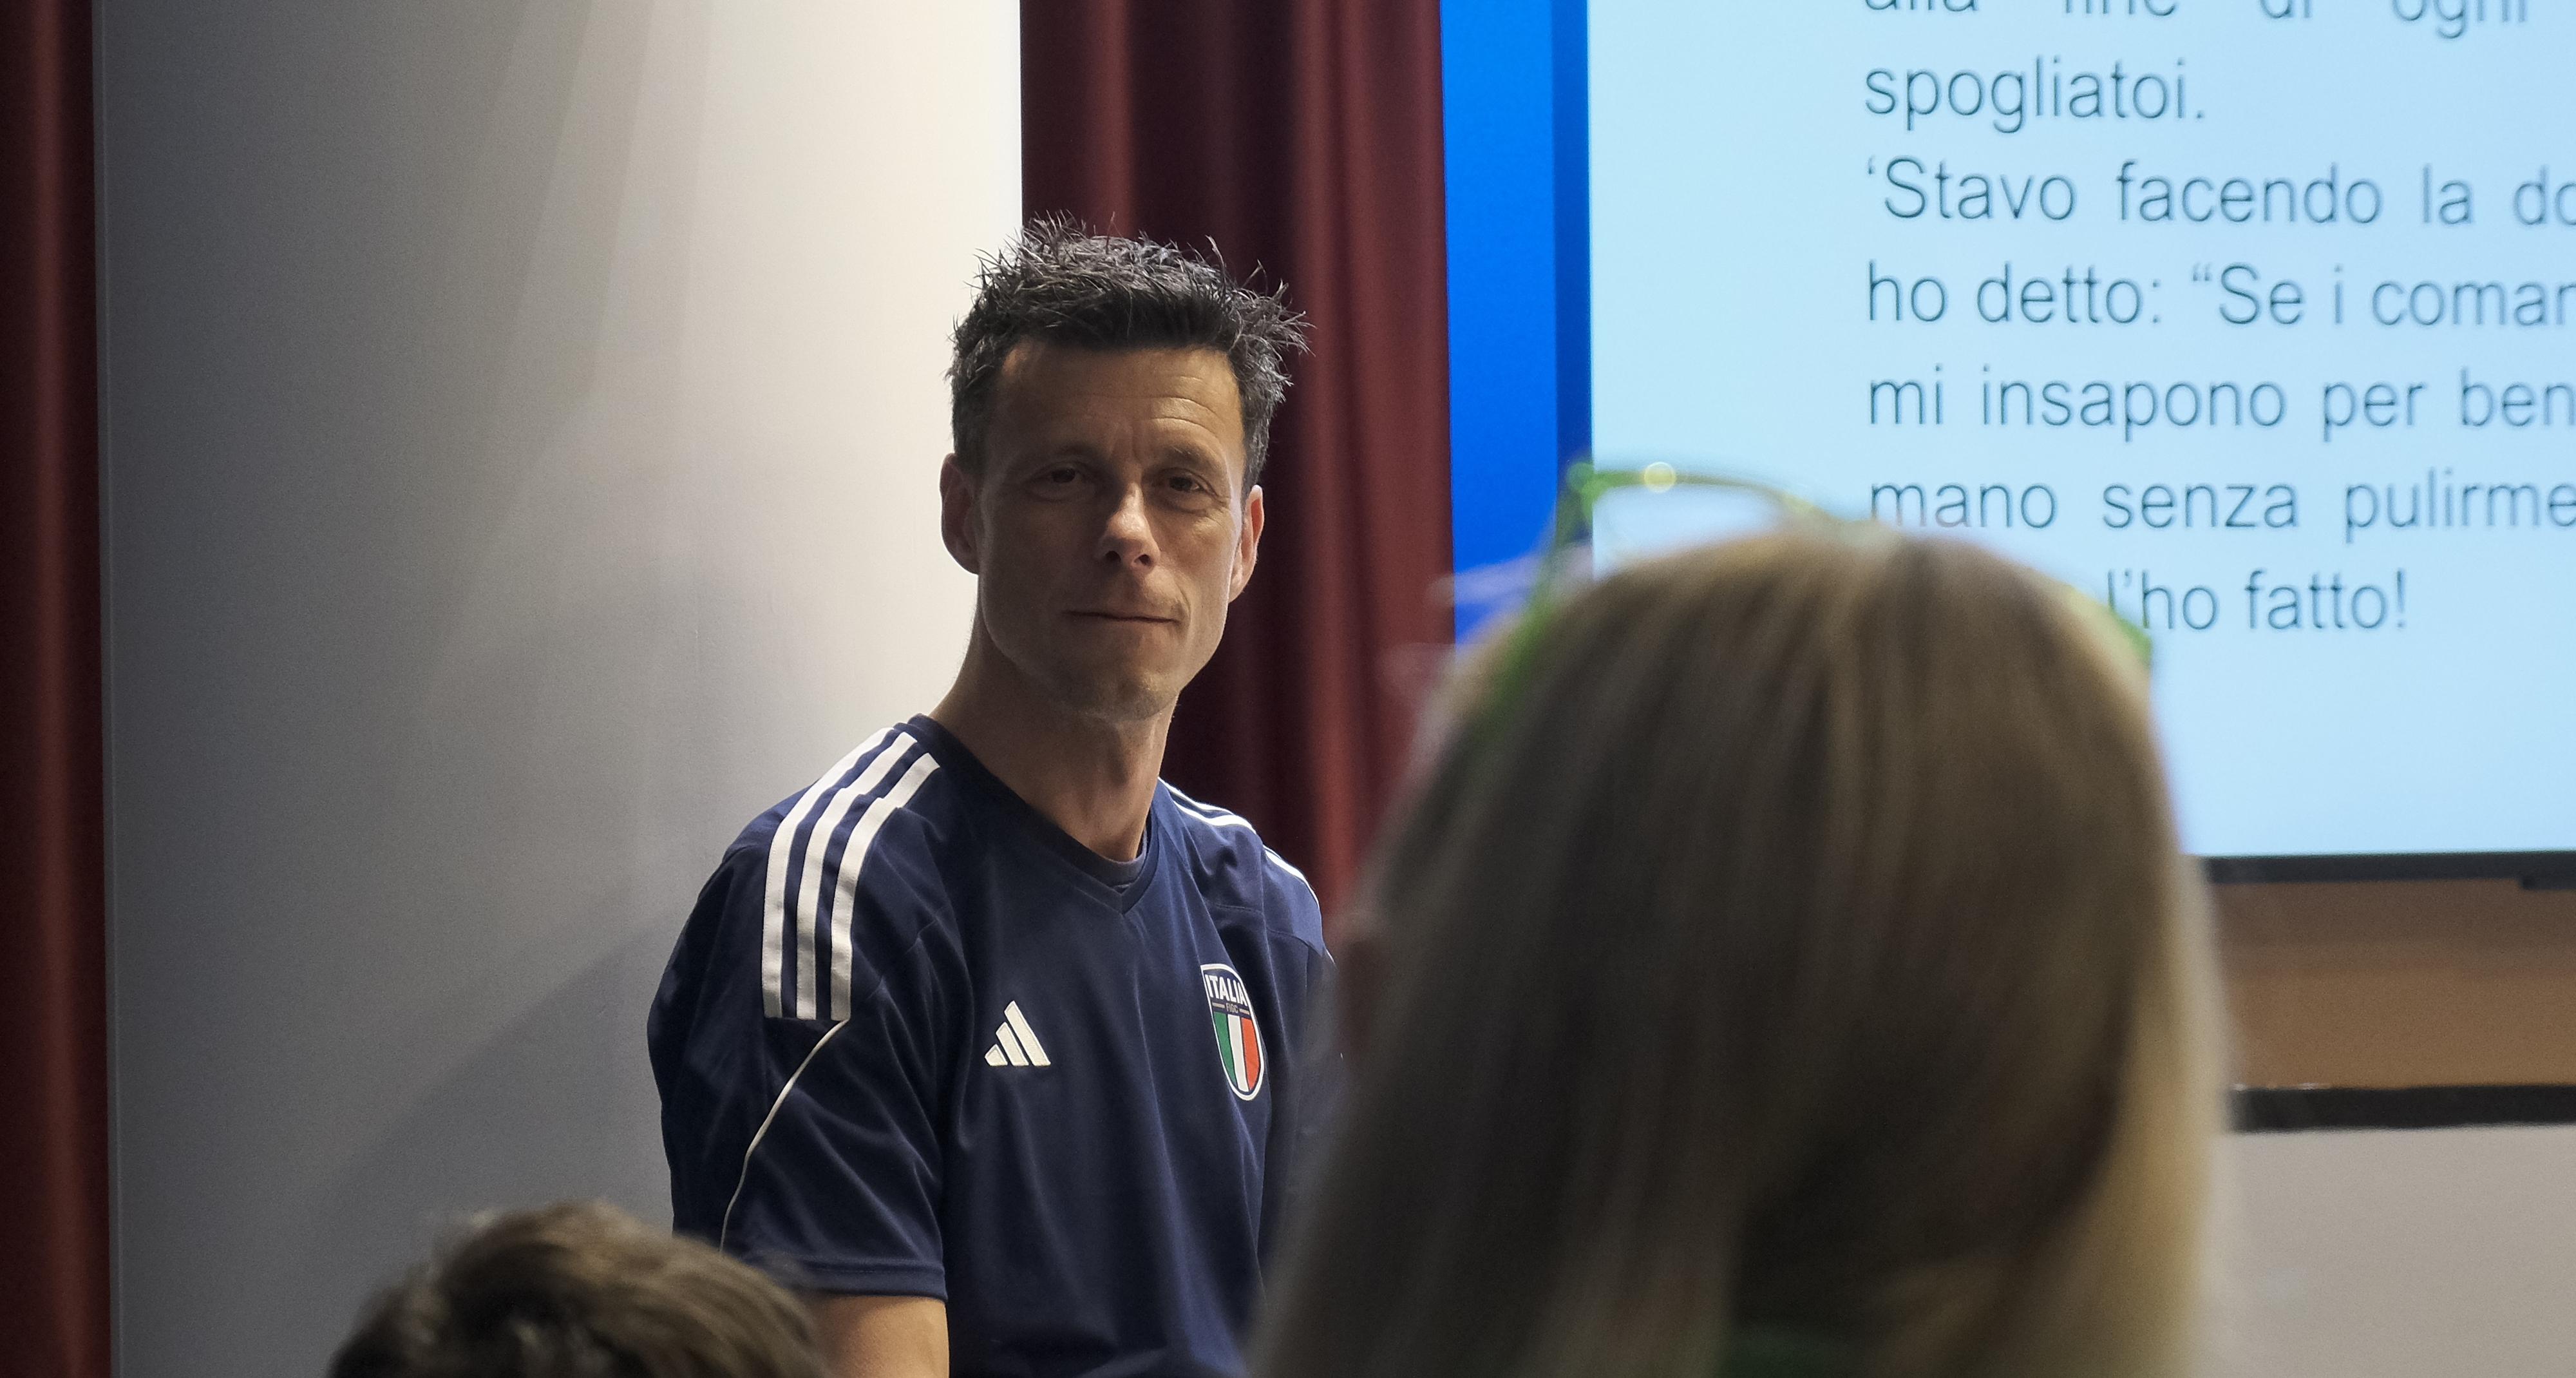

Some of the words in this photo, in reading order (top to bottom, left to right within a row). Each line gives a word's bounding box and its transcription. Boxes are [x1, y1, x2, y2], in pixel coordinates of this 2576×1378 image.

[1866, 55, 2204, 134] spogliatoi.
[2116, 159, 2382, 225] facendo
[2423, 165, 2473, 226] la
[2513, 167, 2576, 227] do
[1868, 260, 1948, 322] ho
[1976, 262, 2160, 325] detto:
[2332, 263, 2345, 326] i
[1870, 364, 1943, 425] mi
[1983, 365, 2287, 443] insapono
[2323, 382, 2425, 443] per
[2460, 368, 2576, 428] ben
[1871, 483, 2058, 529] mano
[2102, 483, 2298, 530] senza
[2345, 469, 2576, 544] pulirme
[2244, 569, 2405, 631] fatto!
[1205, 975, 1248, 1006] ITALIA
